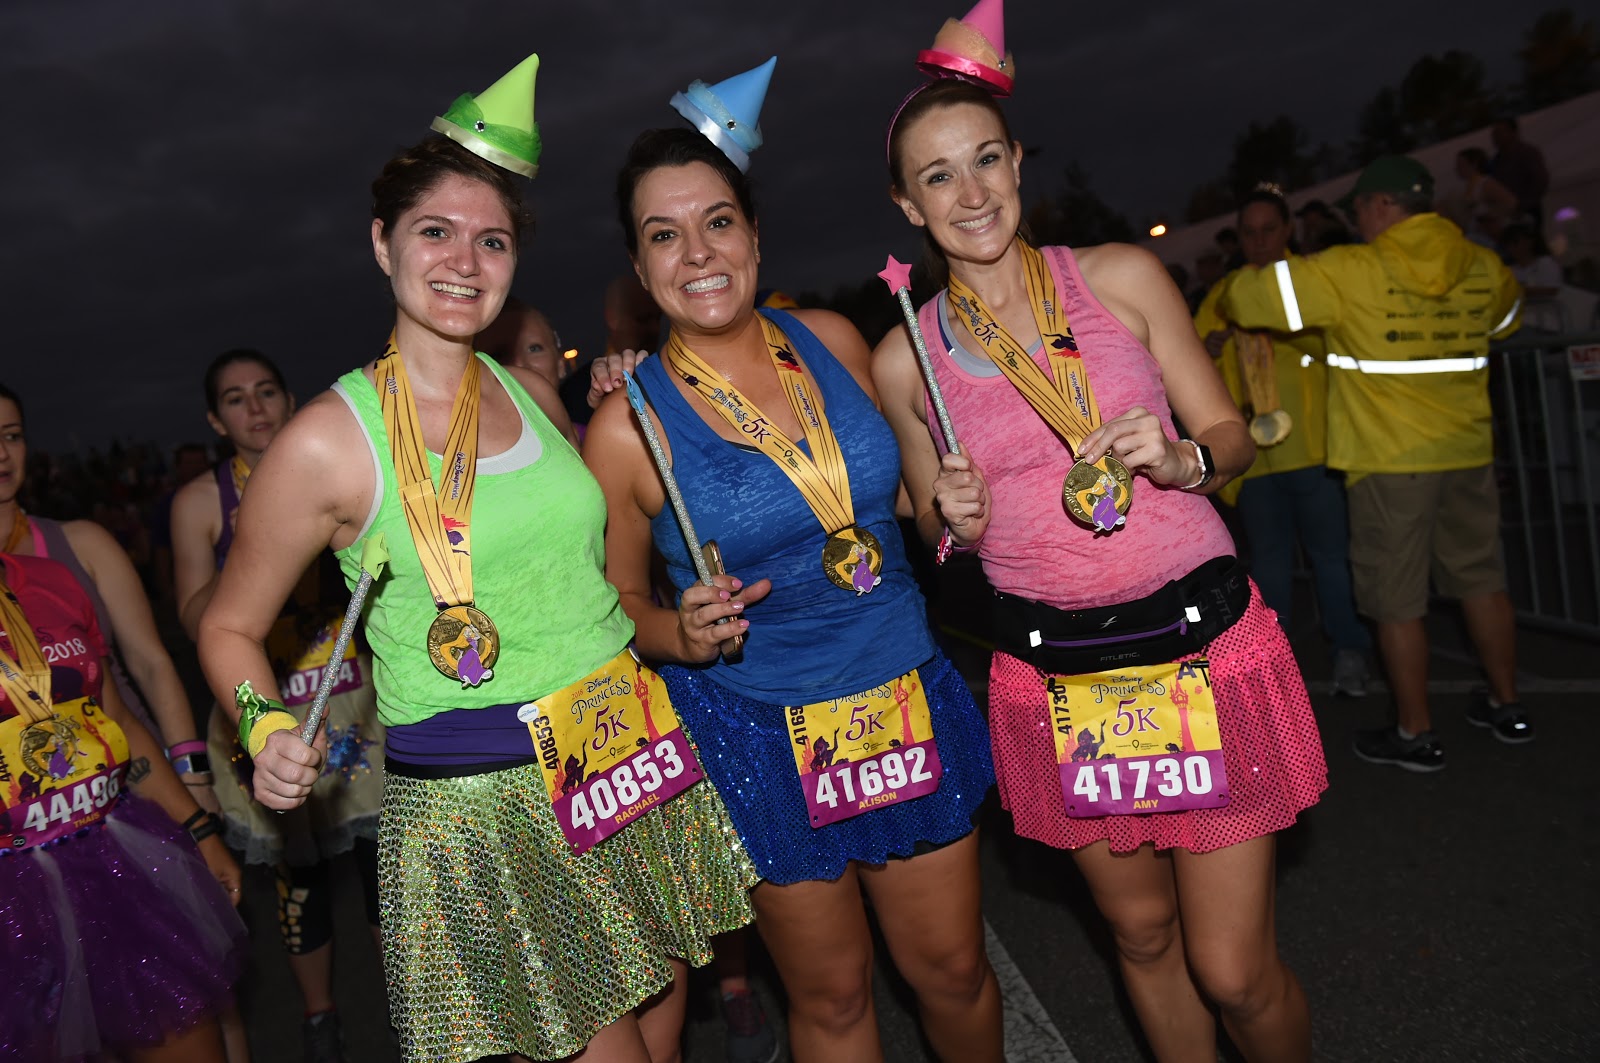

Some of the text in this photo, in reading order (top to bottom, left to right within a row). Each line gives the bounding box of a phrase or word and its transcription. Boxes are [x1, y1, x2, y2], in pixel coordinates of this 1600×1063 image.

[1041, 300, 1055, 315] 2018
[974, 322, 999, 346] 5K
[386, 376, 399, 395] 2018
[710, 387, 749, 423] PRINCESS
[742, 417, 772, 444] 5K
[41, 638, 87, 663] 2018
[1100, 651, 1138, 662] FITLETIC
[281, 661, 354, 699] 074
[1090, 678, 1166, 704] PRINCESS
[571, 674, 632, 724] PRINCESS
[591, 705, 630, 751] 5K
[845, 703, 886, 741] 5K
[1111, 697, 1160, 737] 5K
[533, 715, 559, 770] 40853
[571, 739, 685, 831] 40853
[815, 746, 933, 809] 41692
[1073, 755, 1213, 803] 41730
[613, 792, 661, 825] RACHAEL
[858, 791, 897, 810] ALISON
[1133, 799, 1159, 810] AMY
